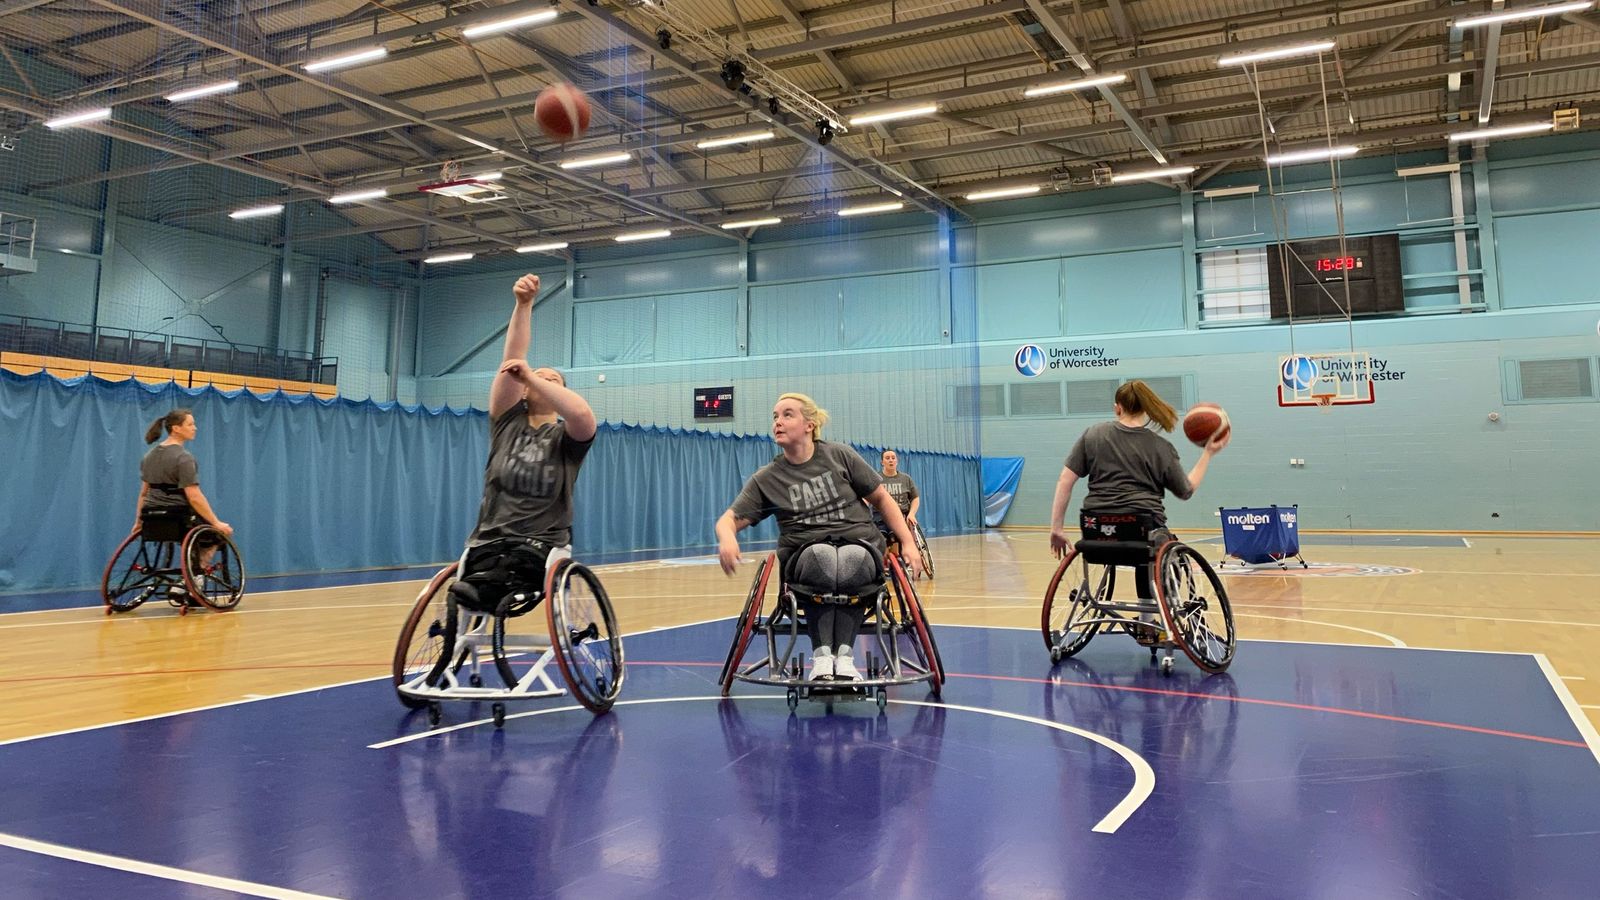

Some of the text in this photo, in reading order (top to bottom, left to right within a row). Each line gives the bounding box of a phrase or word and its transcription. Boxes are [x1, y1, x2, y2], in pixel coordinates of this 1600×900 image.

[1049, 346, 1104, 358] University
[1049, 357, 1119, 369] of Worcester
[1321, 357, 1388, 372] University
[1321, 371, 1334, 383] of
[788, 470, 840, 513] PART
[1227, 513, 1270, 524] molten
